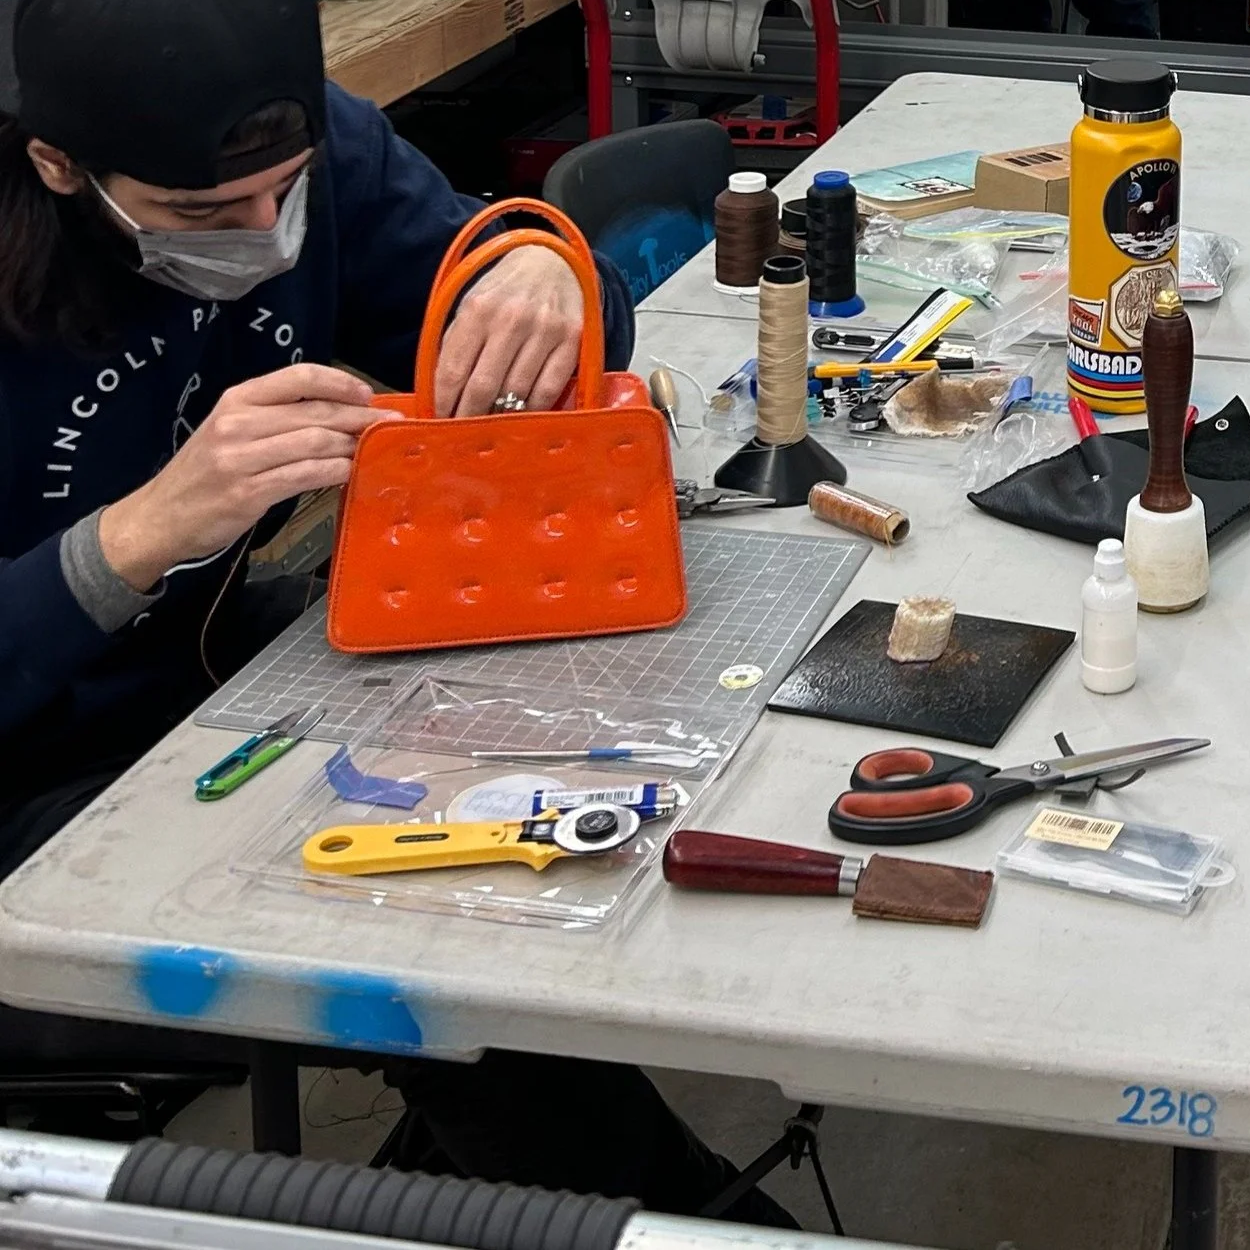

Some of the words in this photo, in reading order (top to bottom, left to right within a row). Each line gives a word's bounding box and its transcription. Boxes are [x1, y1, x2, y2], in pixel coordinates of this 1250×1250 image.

[1129, 162, 1172, 181] APOLLO
[1072, 312, 1095, 334] TOOL
[1072, 326, 1096, 342] LIBRARY
[1067, 341, 1143, 375] ARLSBAD
[1116, 1085, 1218, 1137] 2318
